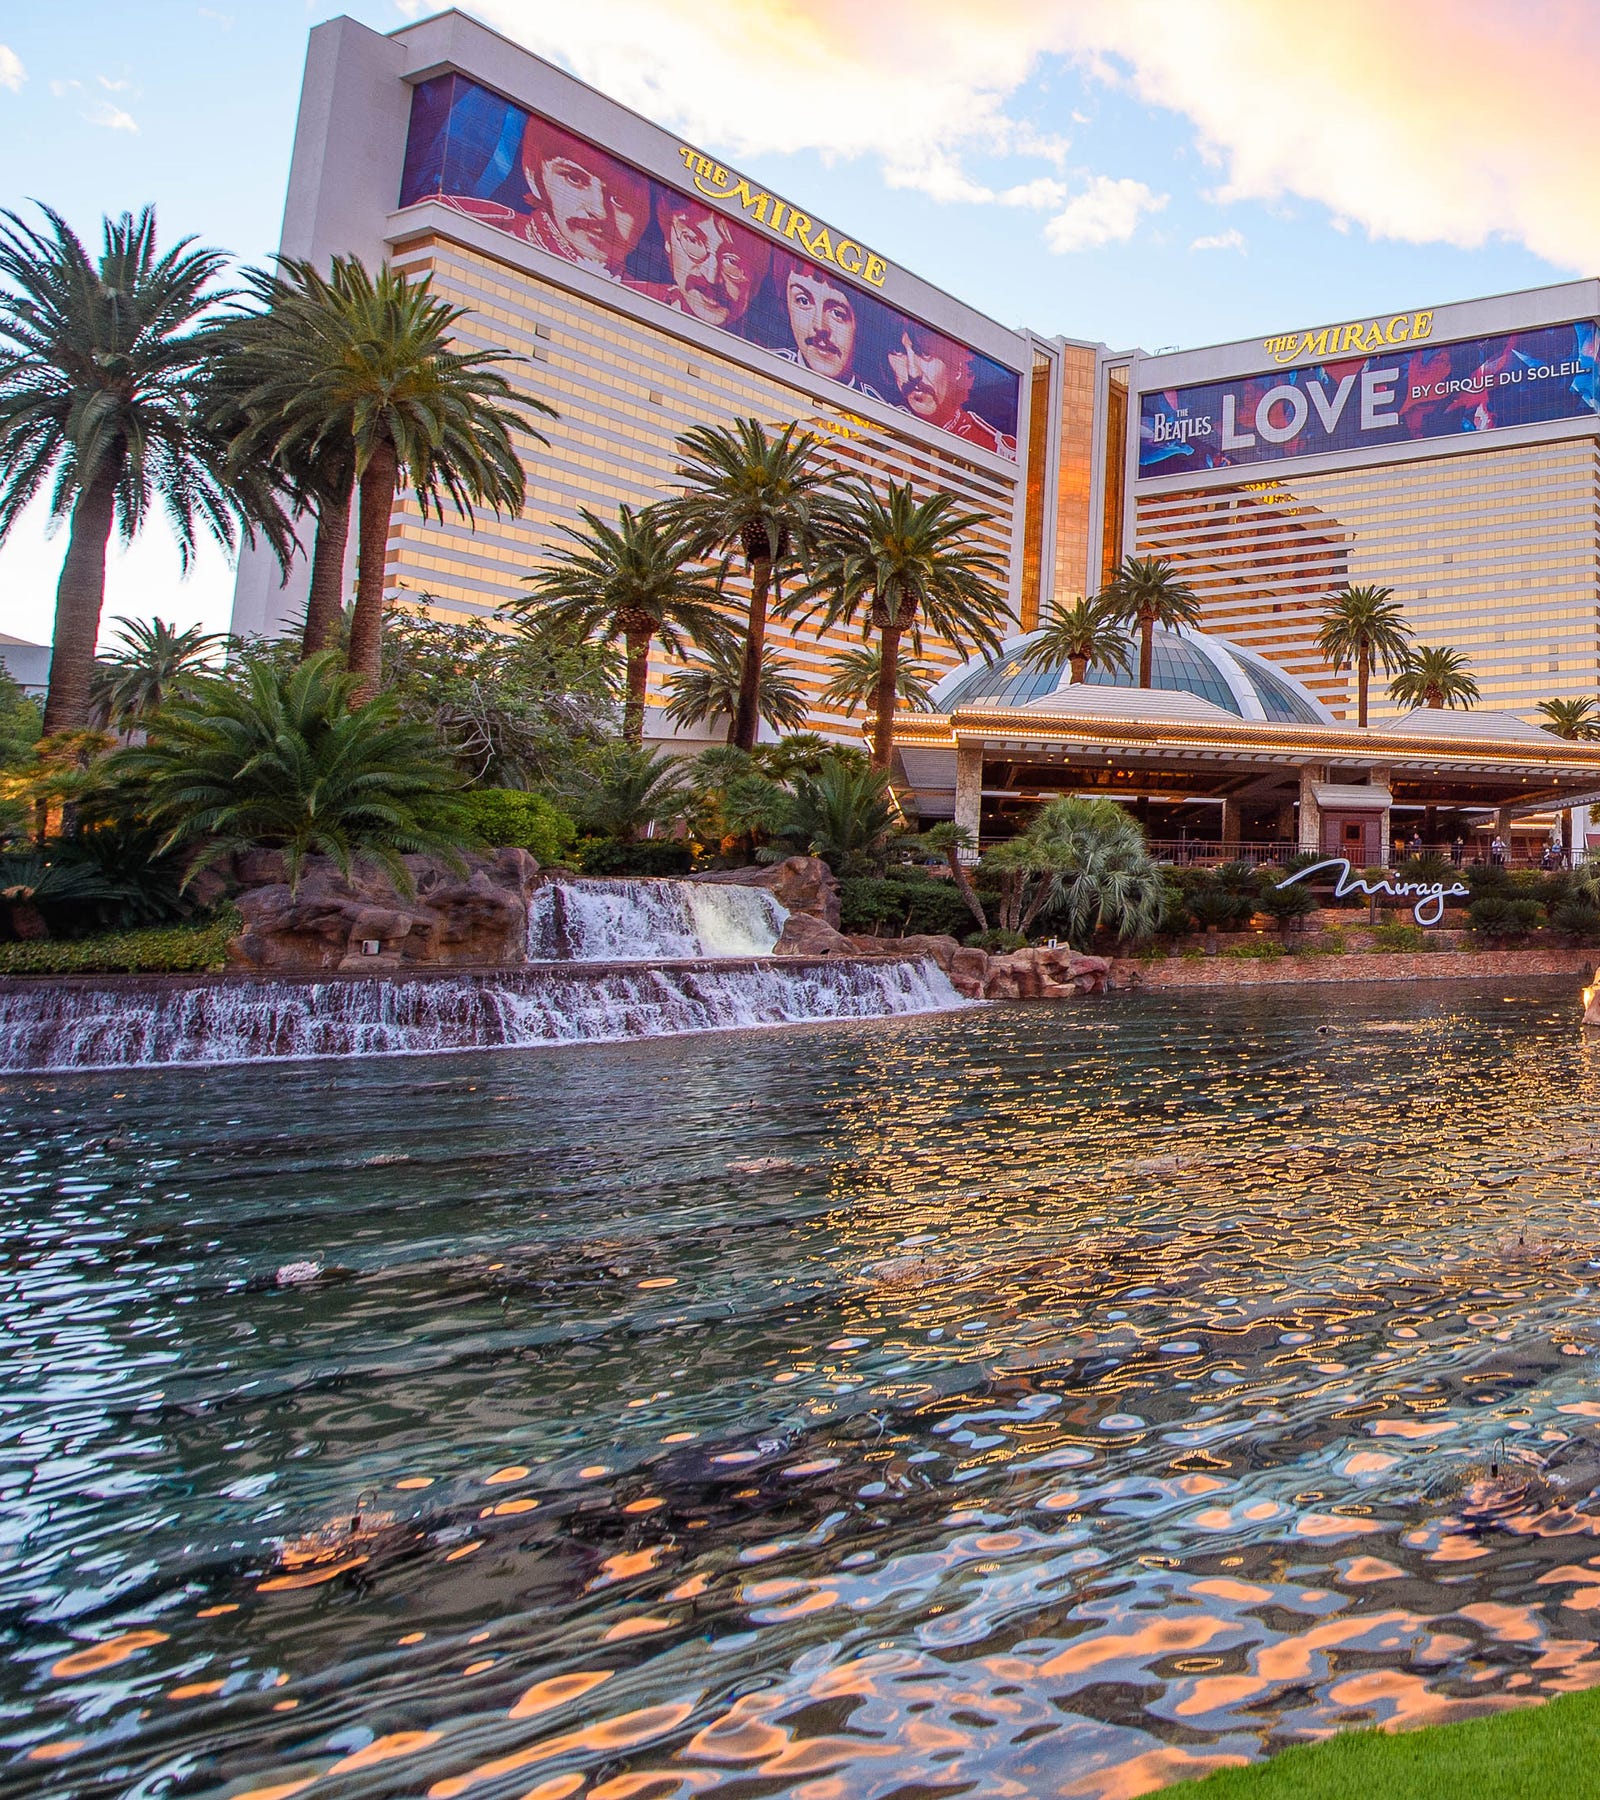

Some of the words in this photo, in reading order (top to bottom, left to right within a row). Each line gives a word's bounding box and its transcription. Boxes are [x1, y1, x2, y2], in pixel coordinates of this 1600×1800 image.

[679, 147, 728, 188] THE
[694, 177, 887, 288] MIRAGE
[1263, 335, 1298, 354] THE
[1274, 311, 1434, 364] MIRAGE
[1411, 384, 1432, 399] BY
[1434, 374, 1494, 395] CIRQUE
[1500, 370, 1522, 385] DU
[1176, 407, 1189, 418] THE
[1221, 367, 1400, 451] LOVE
[1154, 413, 1212, 443] BEATLES
